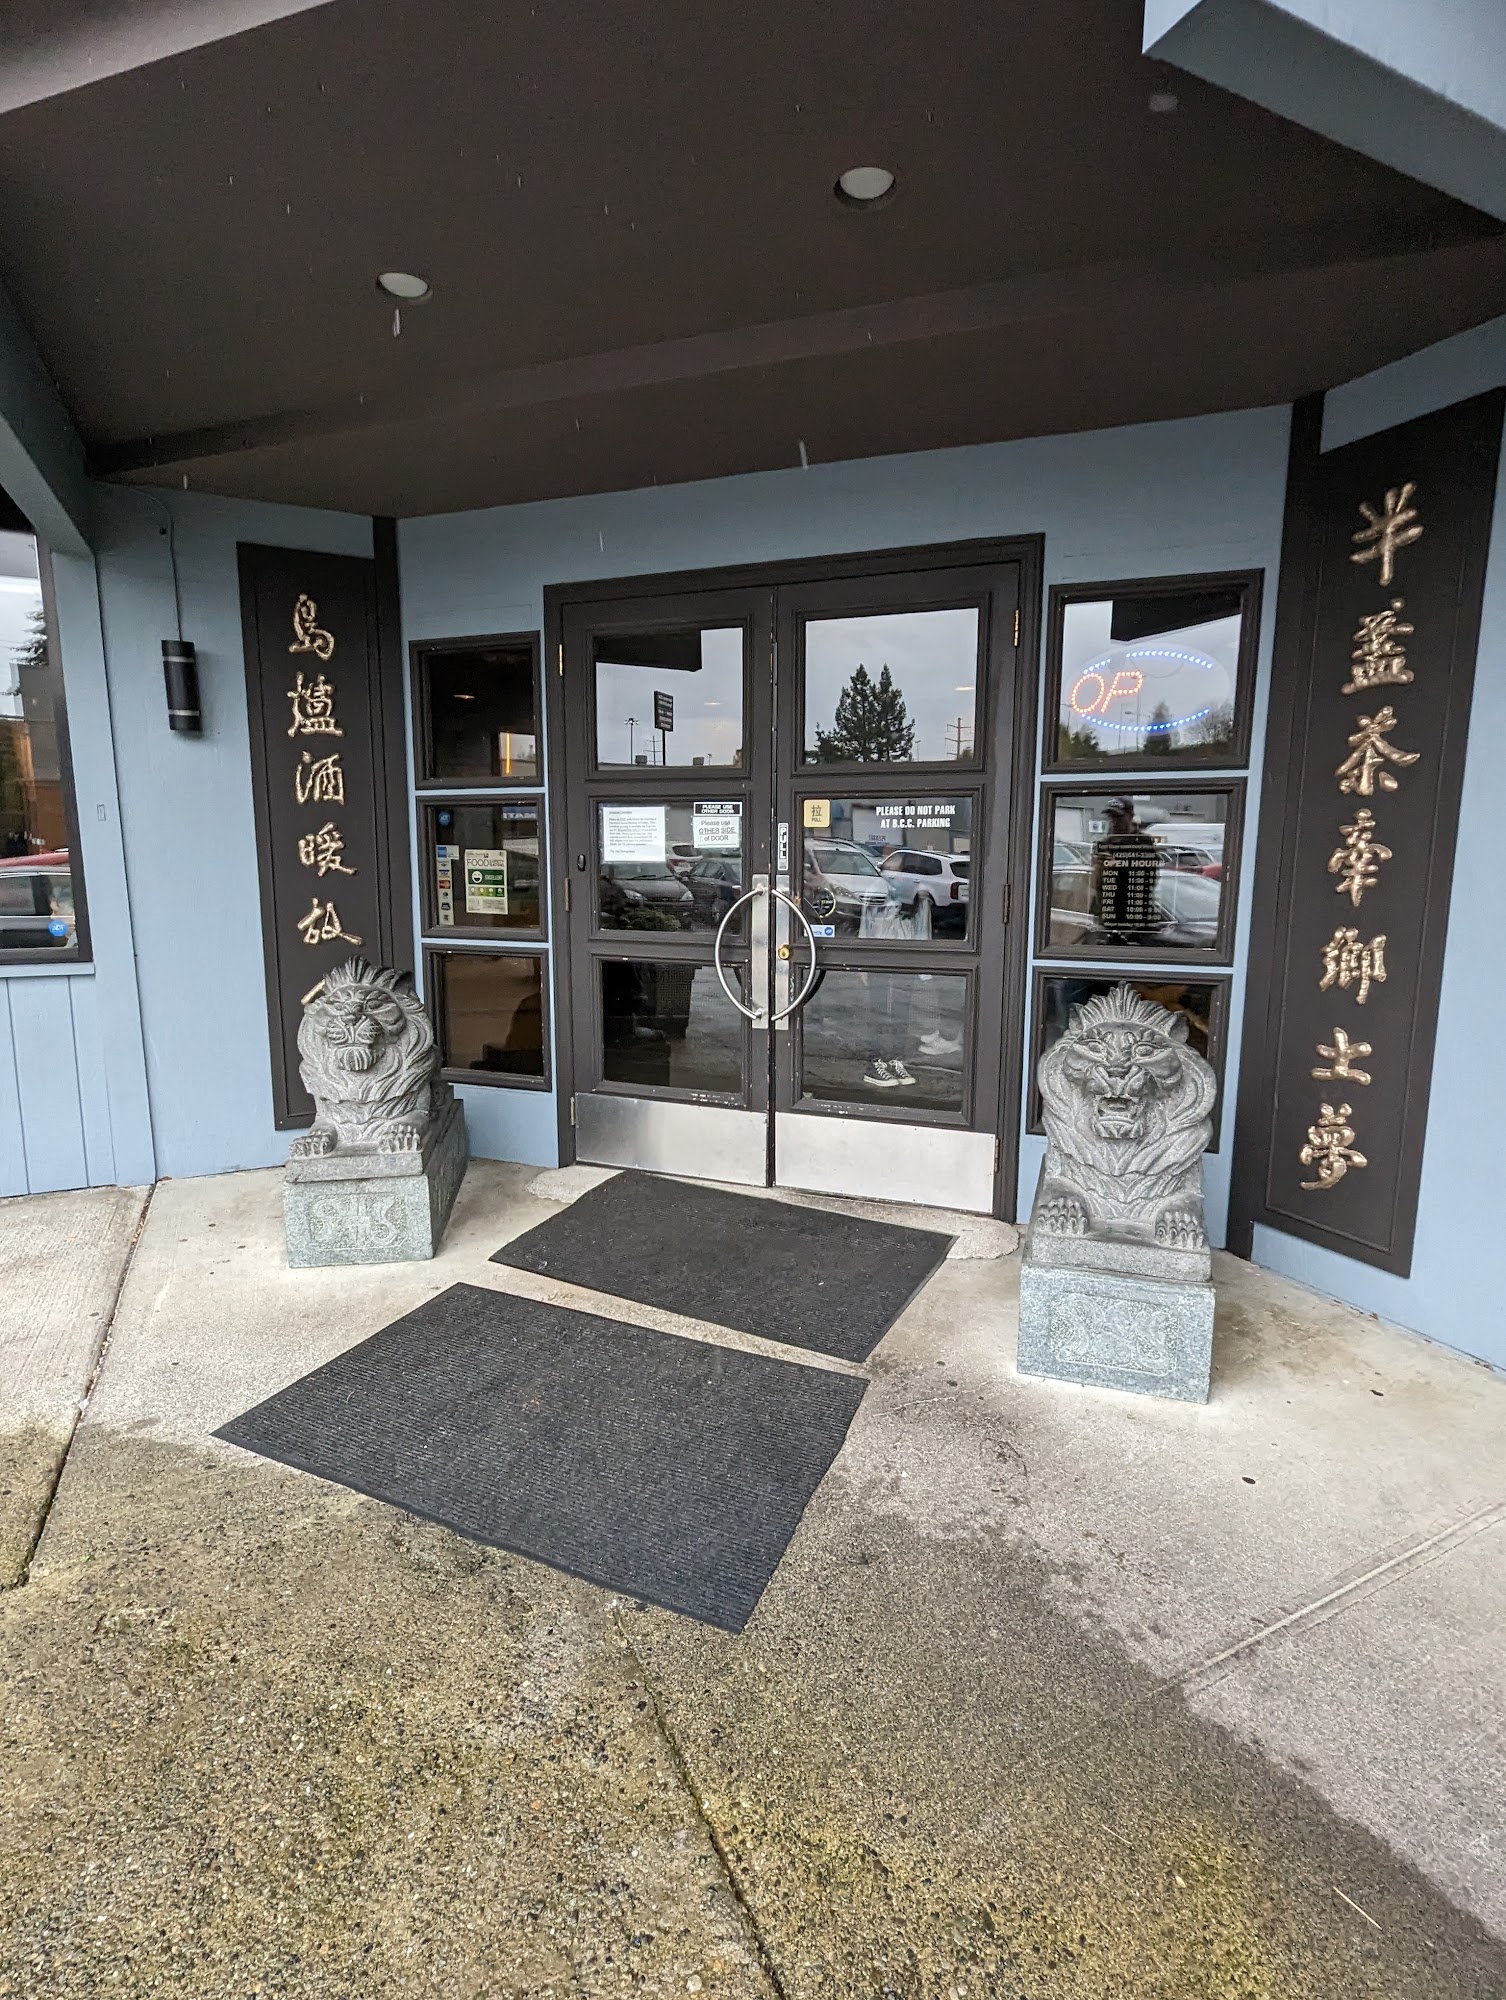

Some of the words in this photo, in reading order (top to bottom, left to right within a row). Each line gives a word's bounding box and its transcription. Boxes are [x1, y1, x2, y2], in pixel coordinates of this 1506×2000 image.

[811, 804, 822, 817] 拉
[876, 806, 903, 816] PLEASE
[904, 806, 915, 815] DO
[917, 805, 932, 815] NOT
[935, 804, 956, 814] PARK
[880, 819, 890, 828] AT
[892, 819, 914, 828] B.C.C.
[917, 818, 950, 828] PARKING
[467, 858, 490, 866] FOOD
